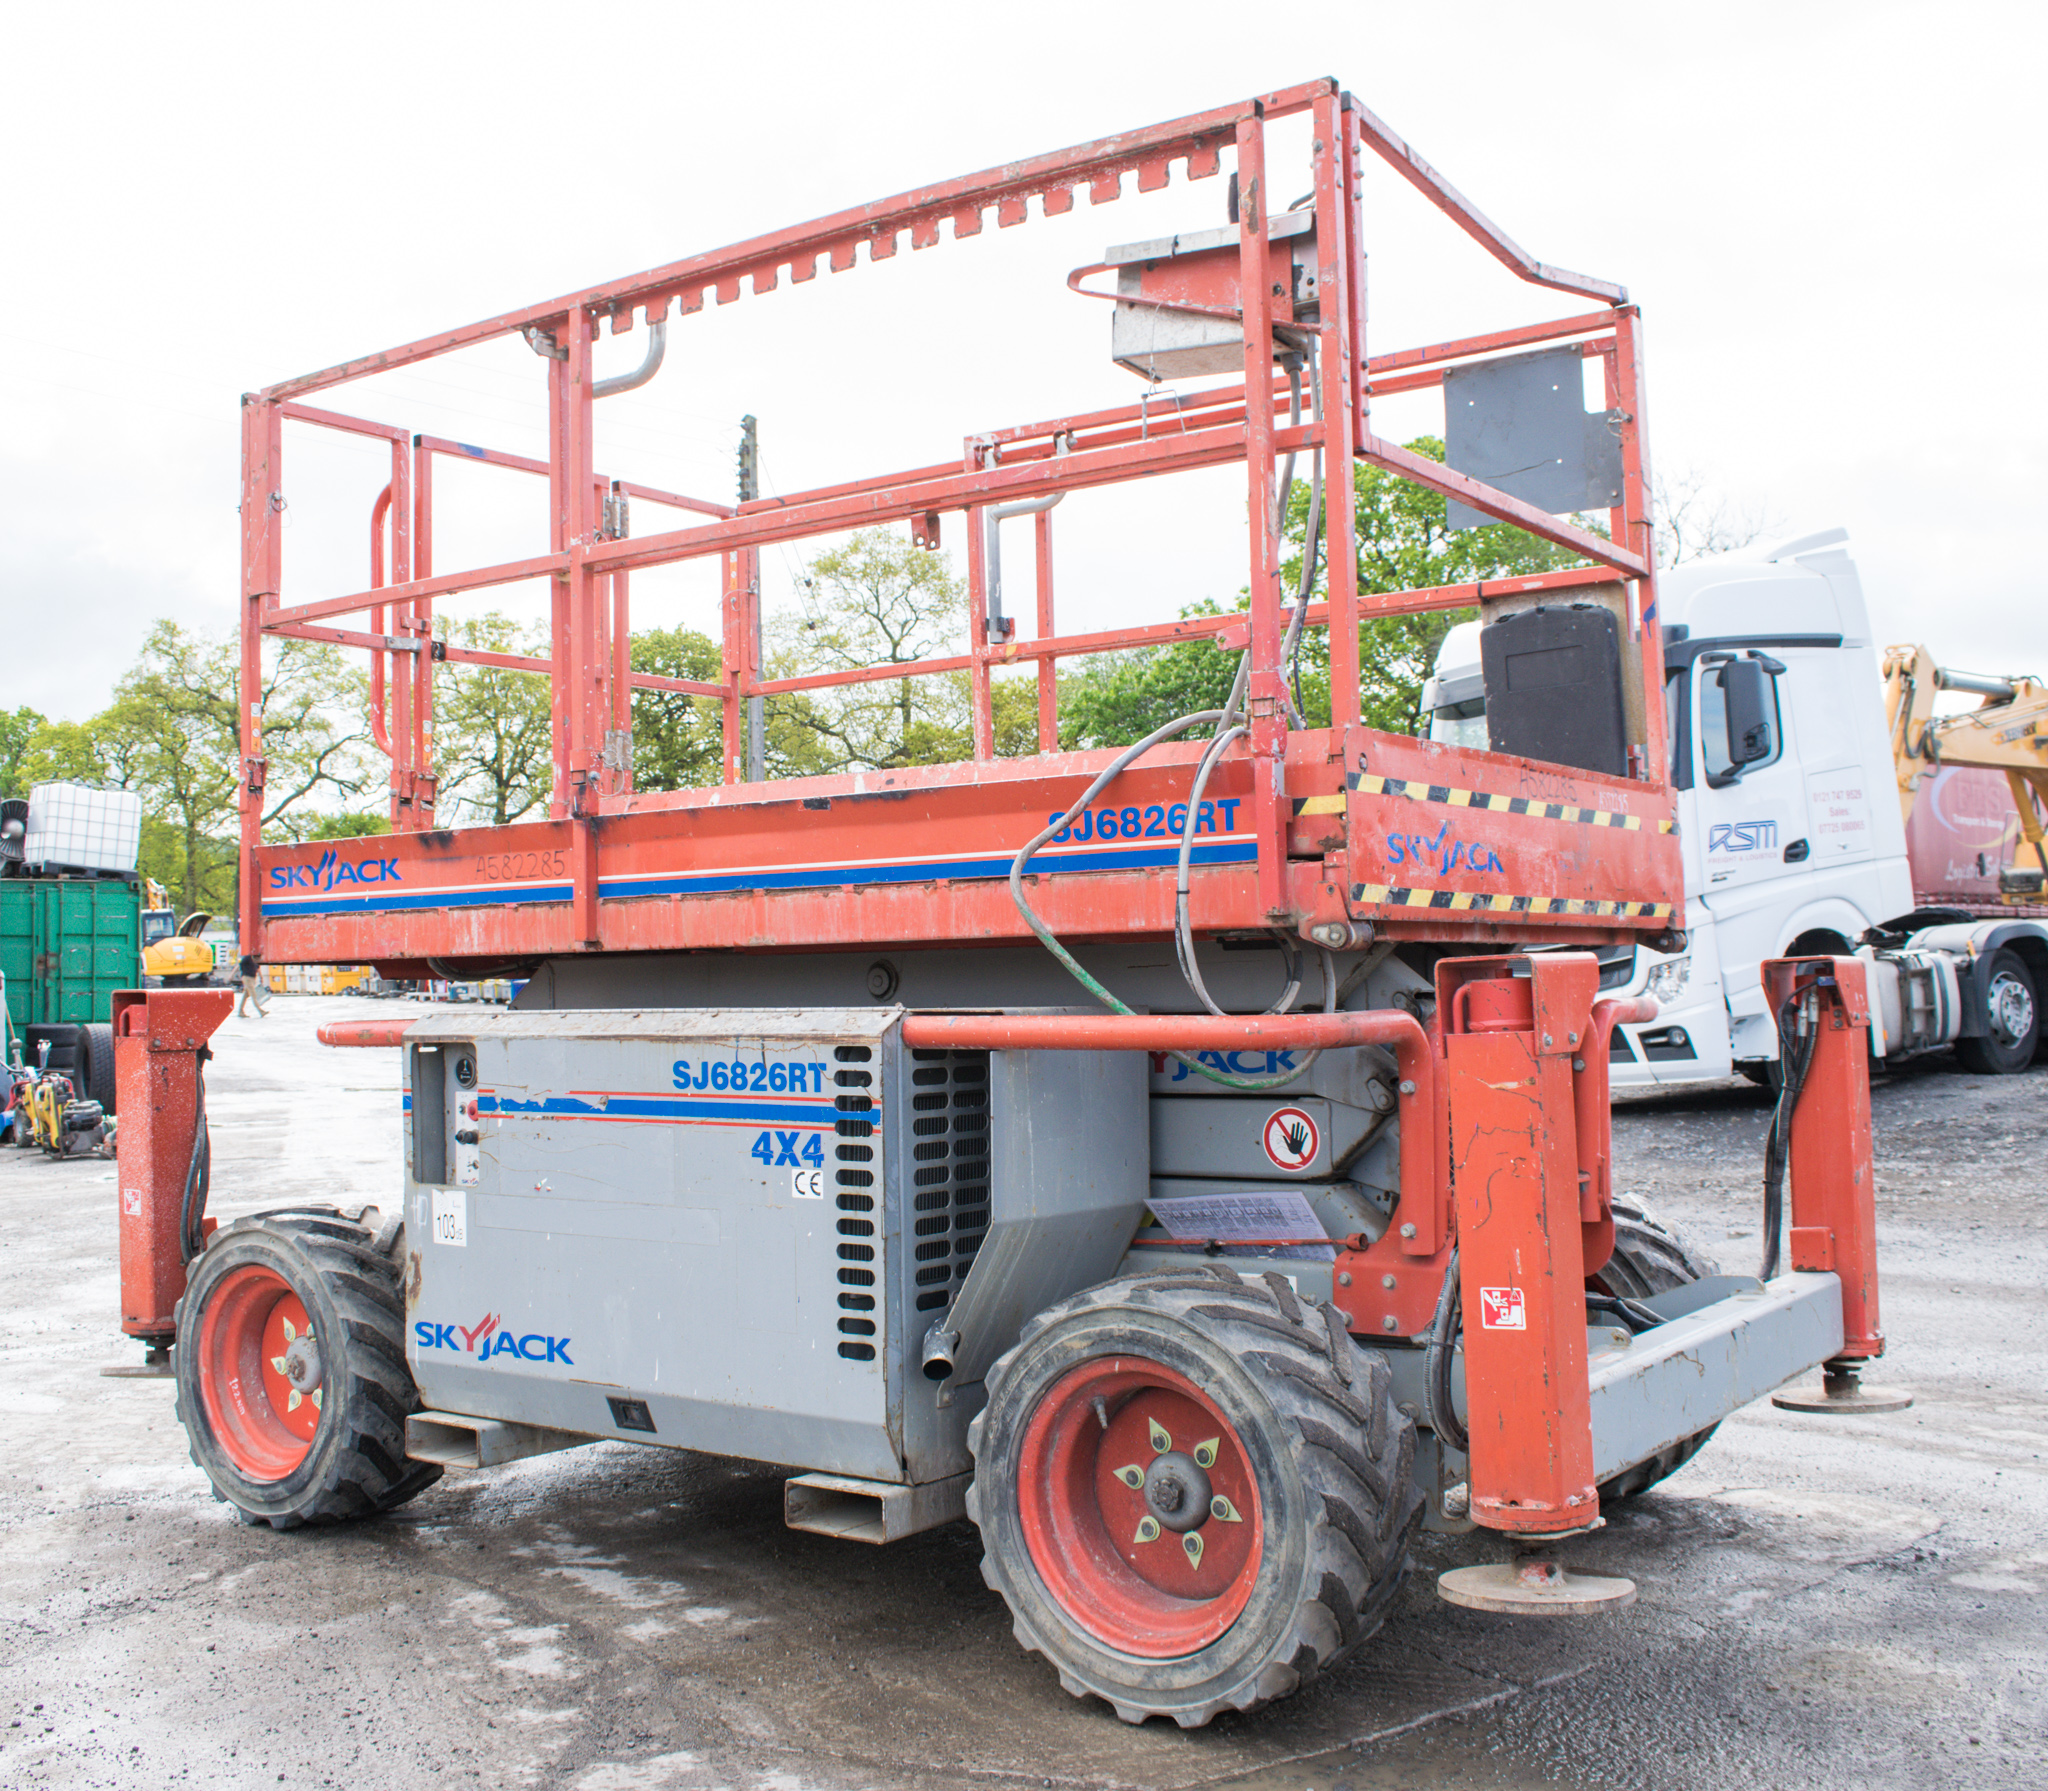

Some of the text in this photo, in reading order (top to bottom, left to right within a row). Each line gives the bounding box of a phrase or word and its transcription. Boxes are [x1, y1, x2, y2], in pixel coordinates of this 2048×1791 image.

[1048, 798, 1241, 843] SJ6826RT
[1387, 820, 1505, 876] SKYJACK
[270, 849, 402, 892] SKYJACK
[672, 1060, 826, 1093] SJ6826RT
[751, 1131, 824, 1168] 4X4
[437, 1213, 456, 1239] 103
[414, 1312, 575, 1365] SKYJACK
